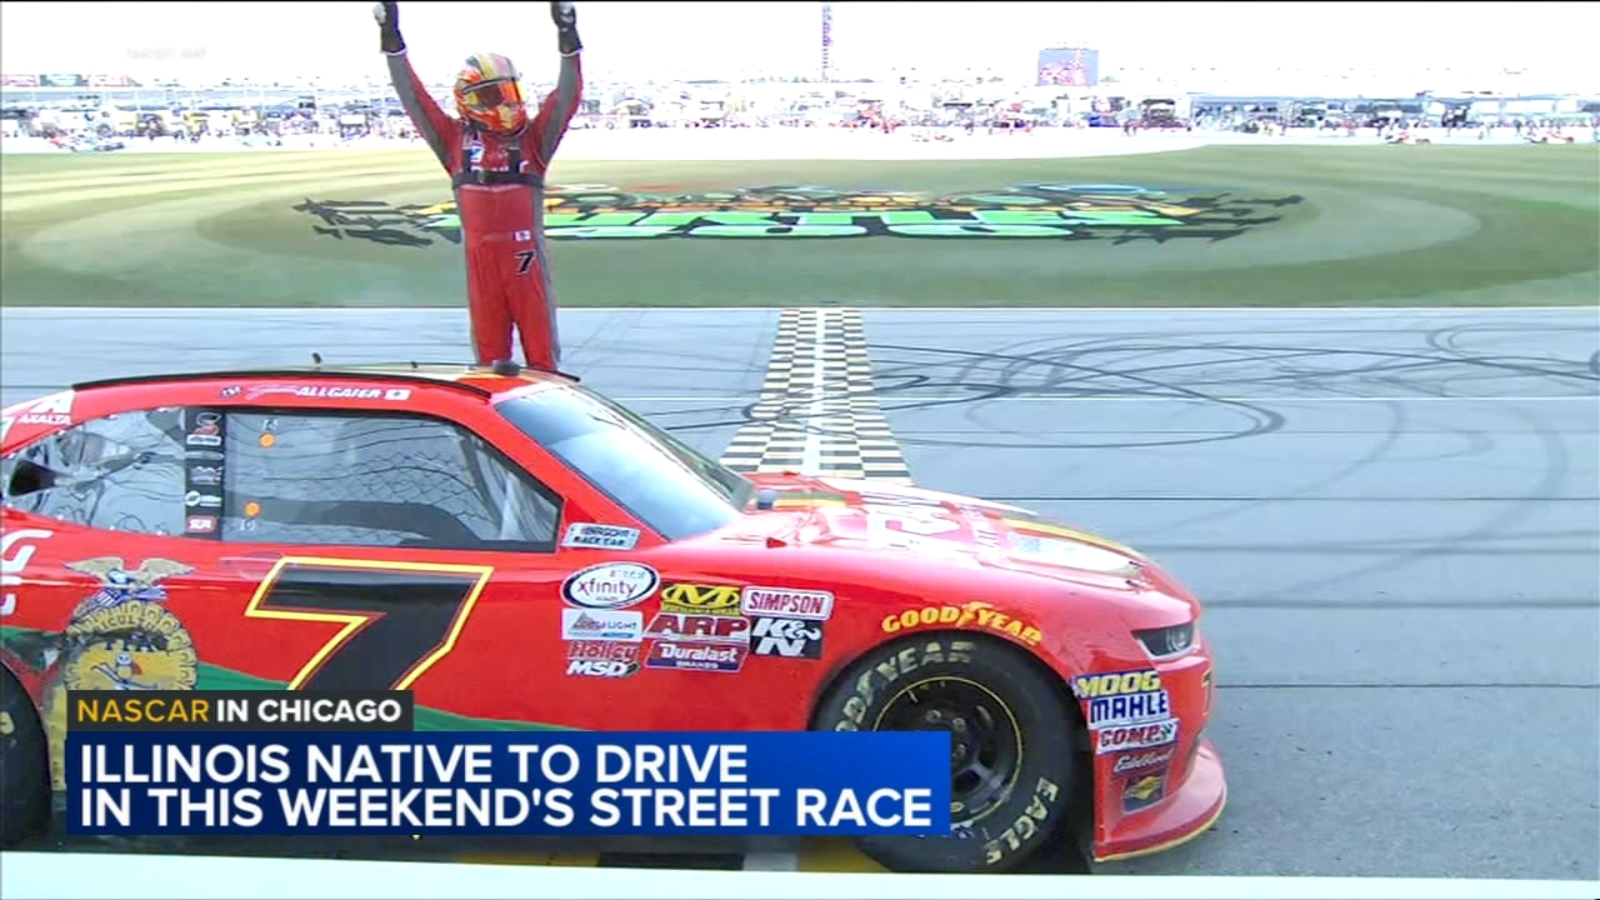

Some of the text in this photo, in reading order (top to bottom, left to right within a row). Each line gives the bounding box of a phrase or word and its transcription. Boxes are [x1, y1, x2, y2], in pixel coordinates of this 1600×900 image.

[514, 250, 536, 273] 7
[577, 577, 638, 599] xfinity
[748, 591, 823, 614] SIMPSON
[244, 555, 495, 690] 7
[648, 614, 749, 636] ARP
[567, 640, 638, 659] Holley
[659, 644, 738, 662] Duralast
[566, 660, 629, 676] MSD
[1076, 670, 1161, 699] MOOG
[1090, 691, 1168, 723] MAHLE
[986, 777, 1058, 864] EAGLE
